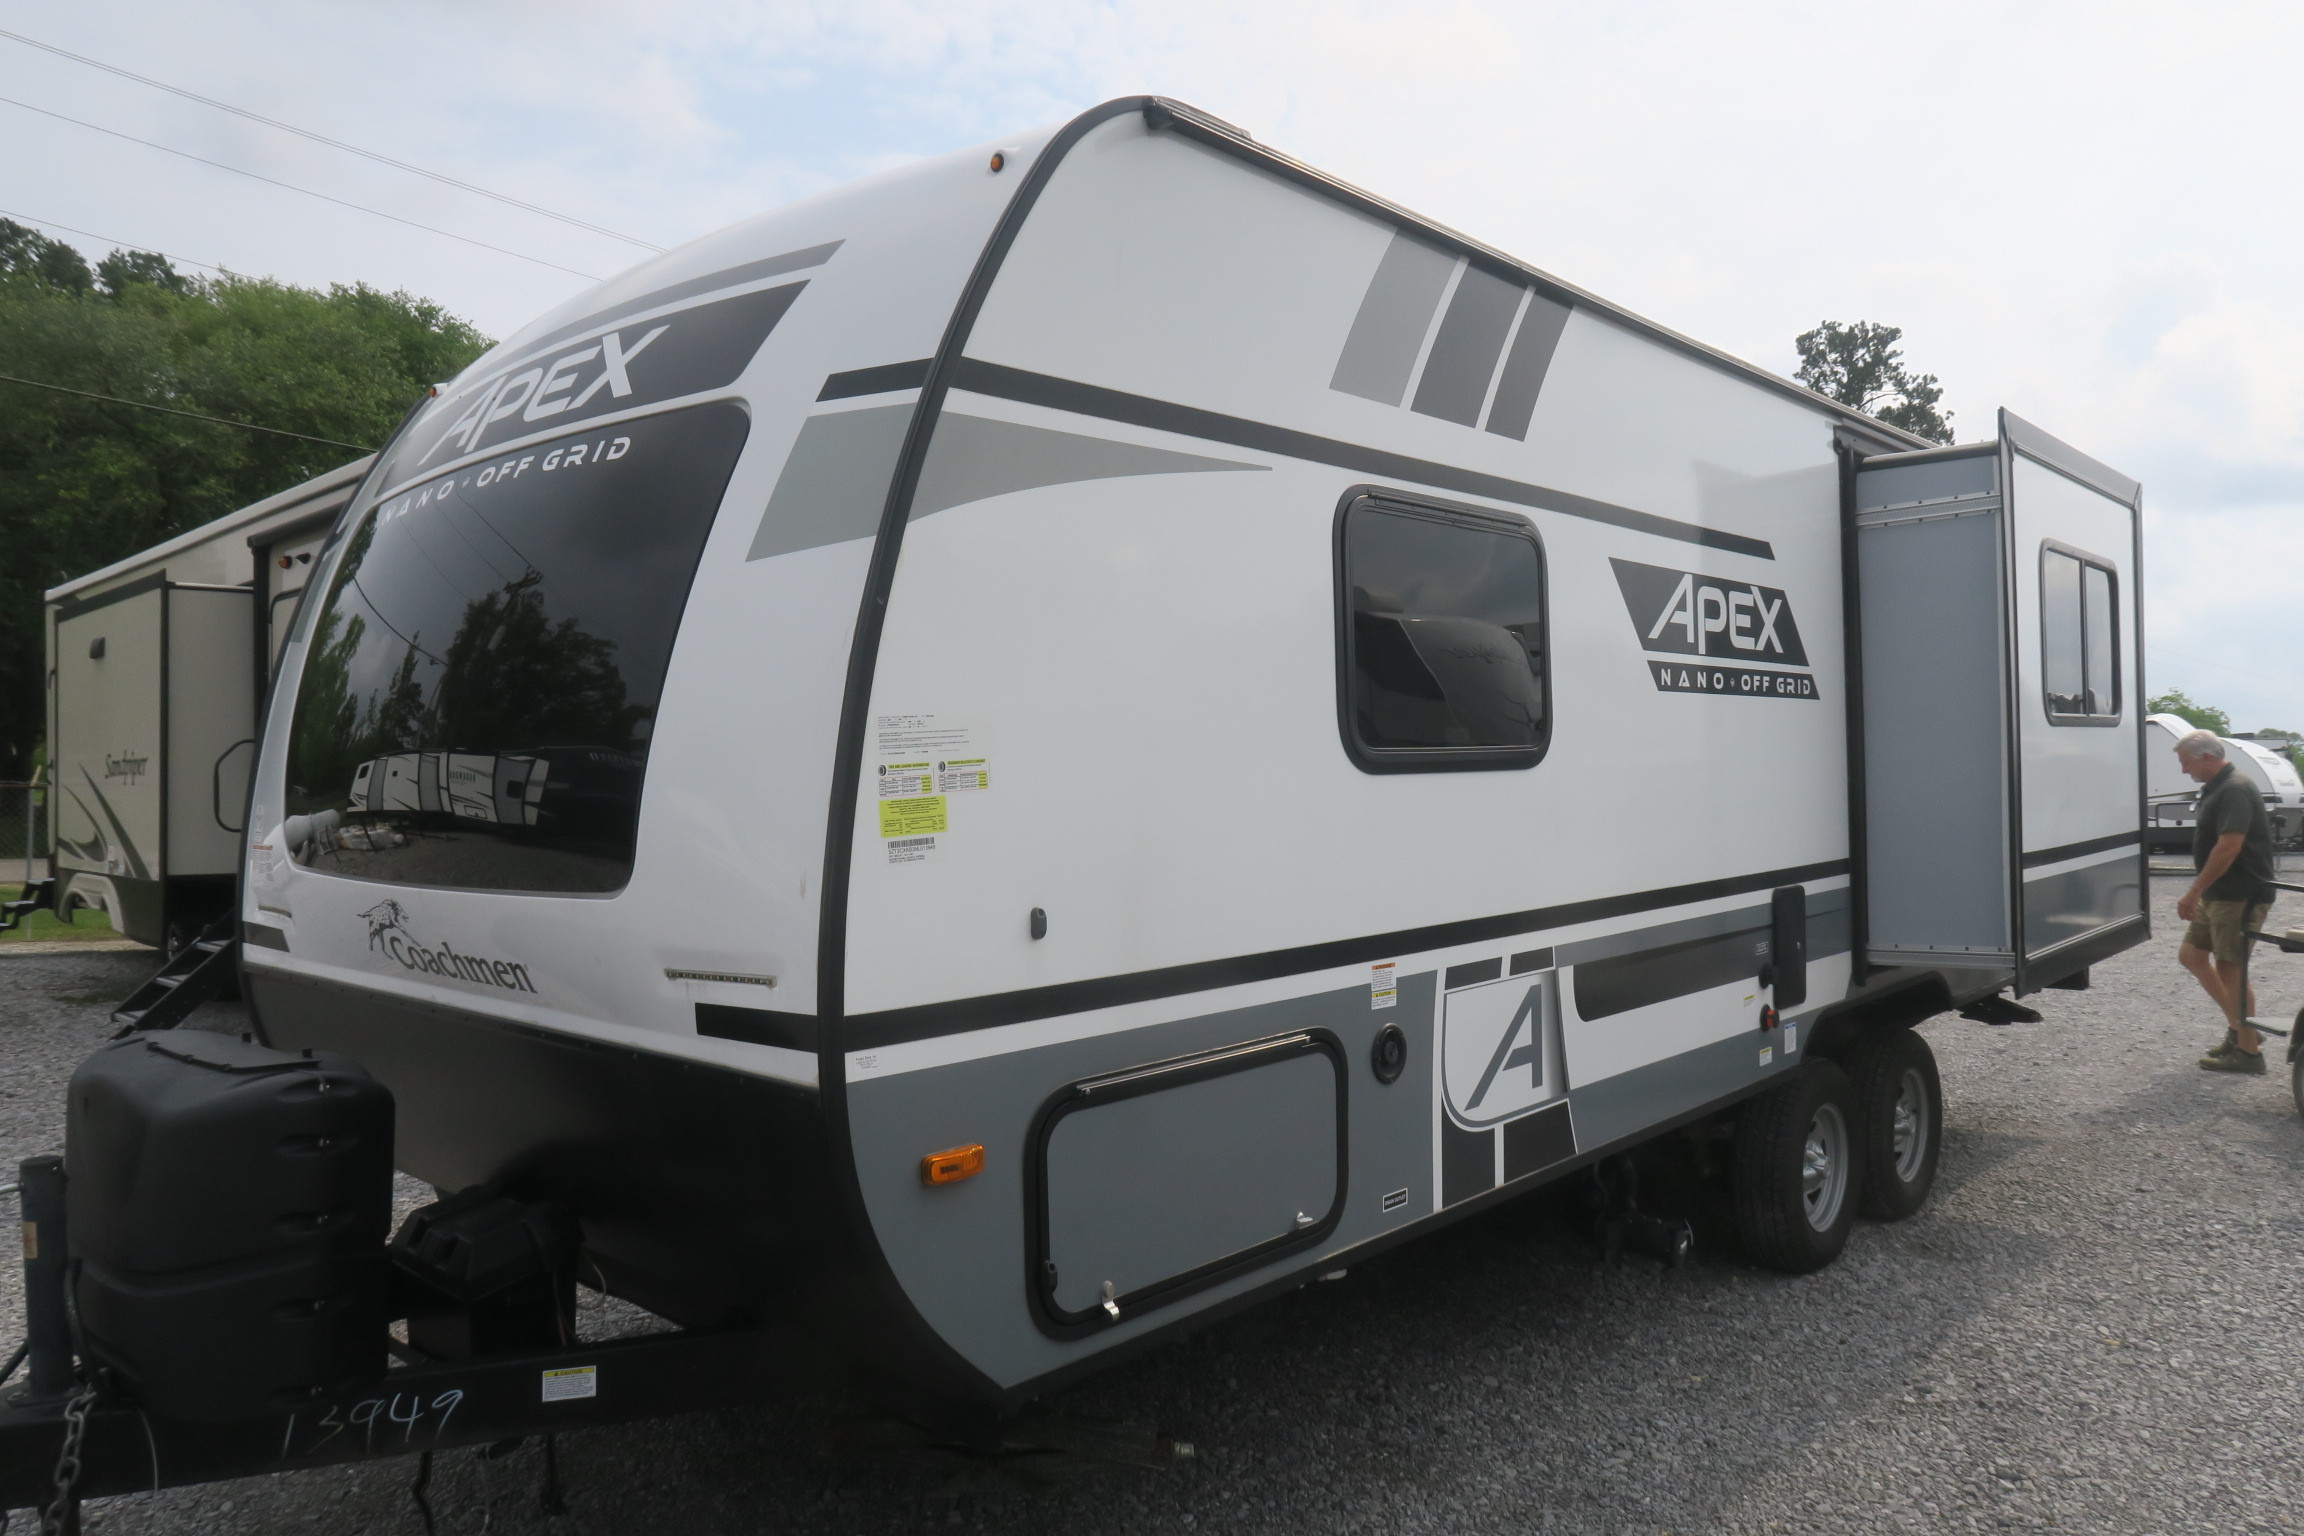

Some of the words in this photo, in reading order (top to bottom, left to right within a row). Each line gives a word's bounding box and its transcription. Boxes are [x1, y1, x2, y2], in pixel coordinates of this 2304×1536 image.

[417, 324, 671, 467] APEX
[380, 480, 456, 526] NANO
[476, 455, 535, 488] OFF
[541, 436, 632, 471] GRID
[1647, 573, 1784, 655] APEX
[1660, 668, 1724, 690] NANO
[1740, 672, 1770, 692] OFF
[1776, 677, 1811, 695] GRID
[389, 936, 538, 995] Coachmen
[1464, 983, 1543, 1112] A
